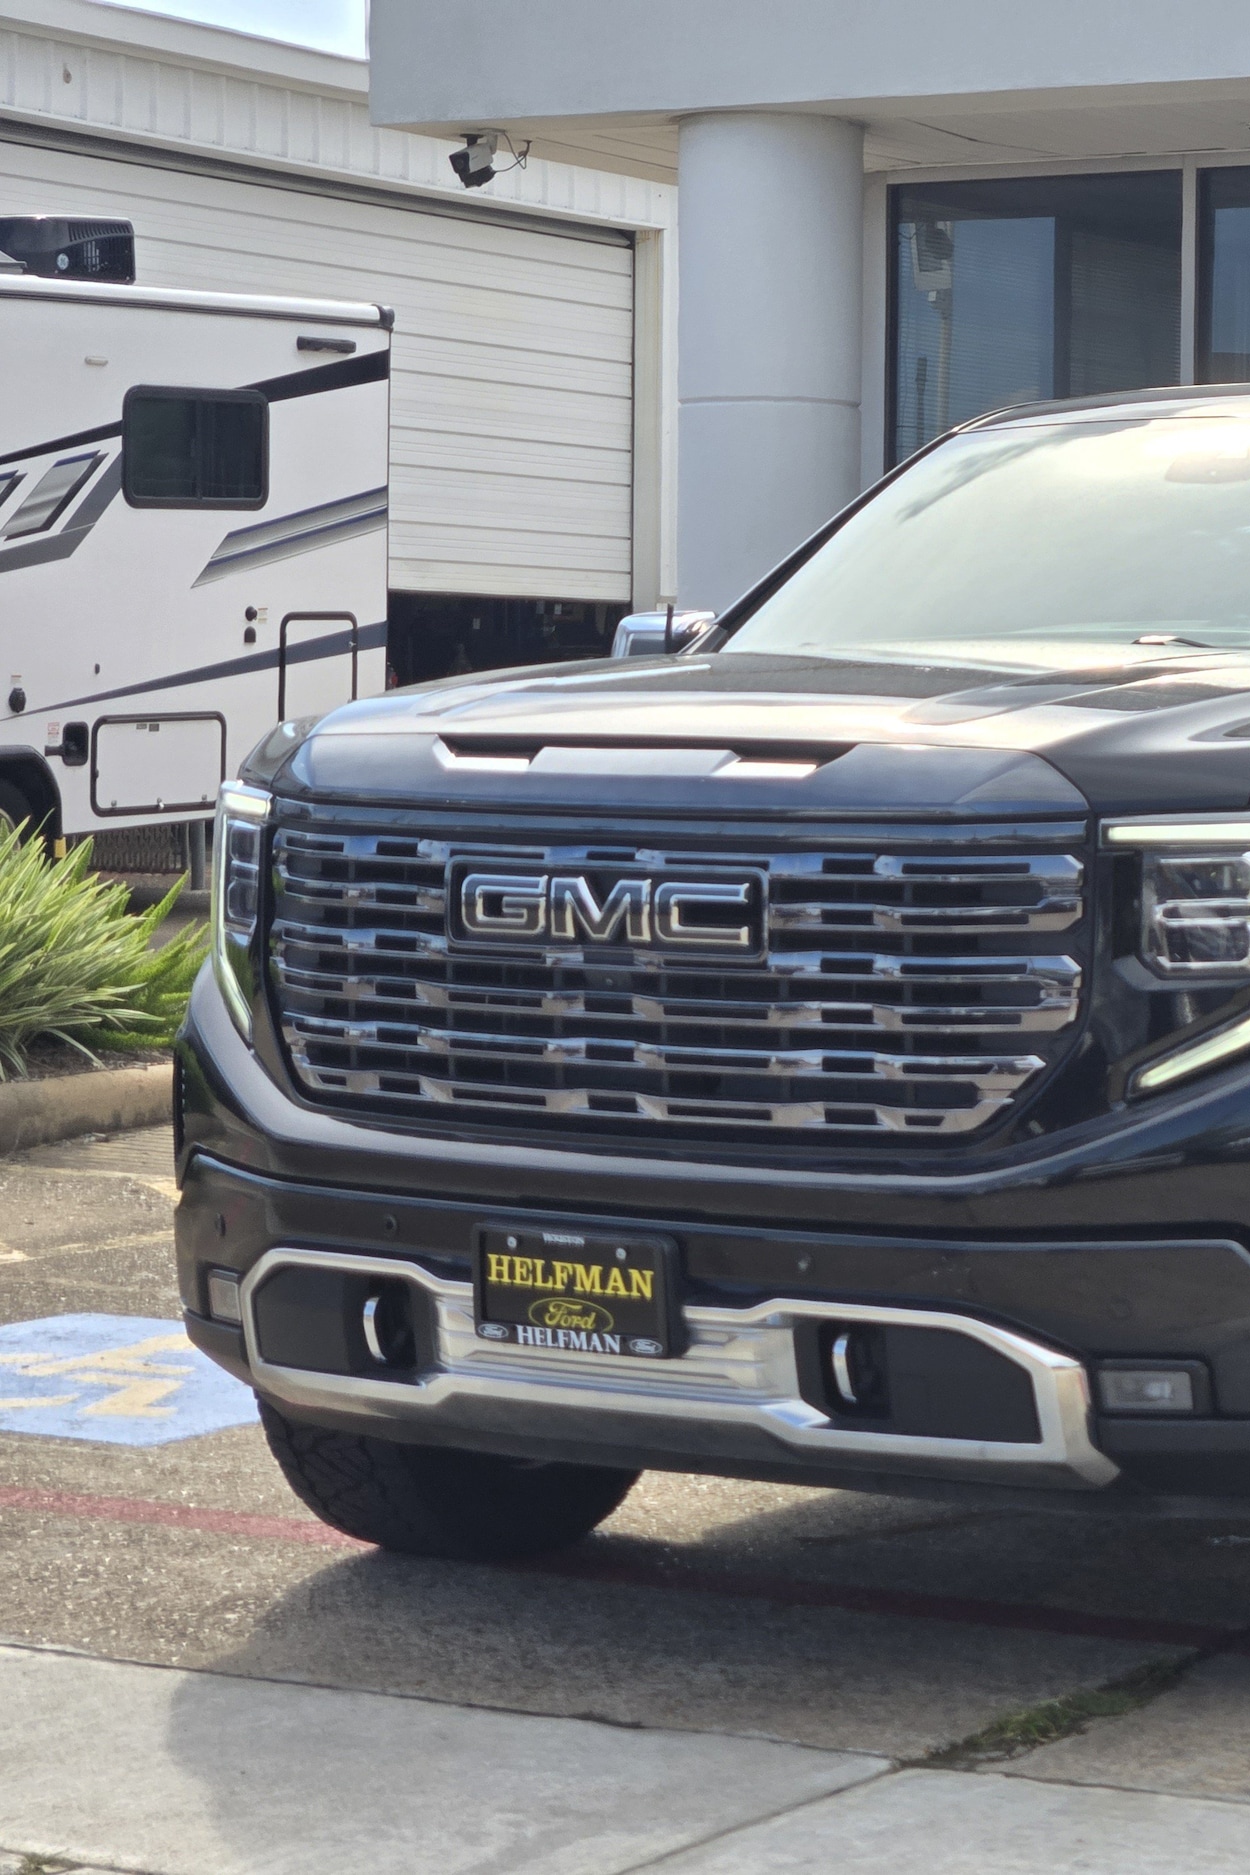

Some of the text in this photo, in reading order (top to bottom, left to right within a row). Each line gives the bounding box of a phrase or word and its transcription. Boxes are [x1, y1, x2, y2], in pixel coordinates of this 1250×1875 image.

[461, 873, 749, 946] GMC
[487, 1253, 654, 1299] HELFMAN
[544, 1301, 596, 1330] Ford
[516, 1323, 621, 1354] HELFMAN
